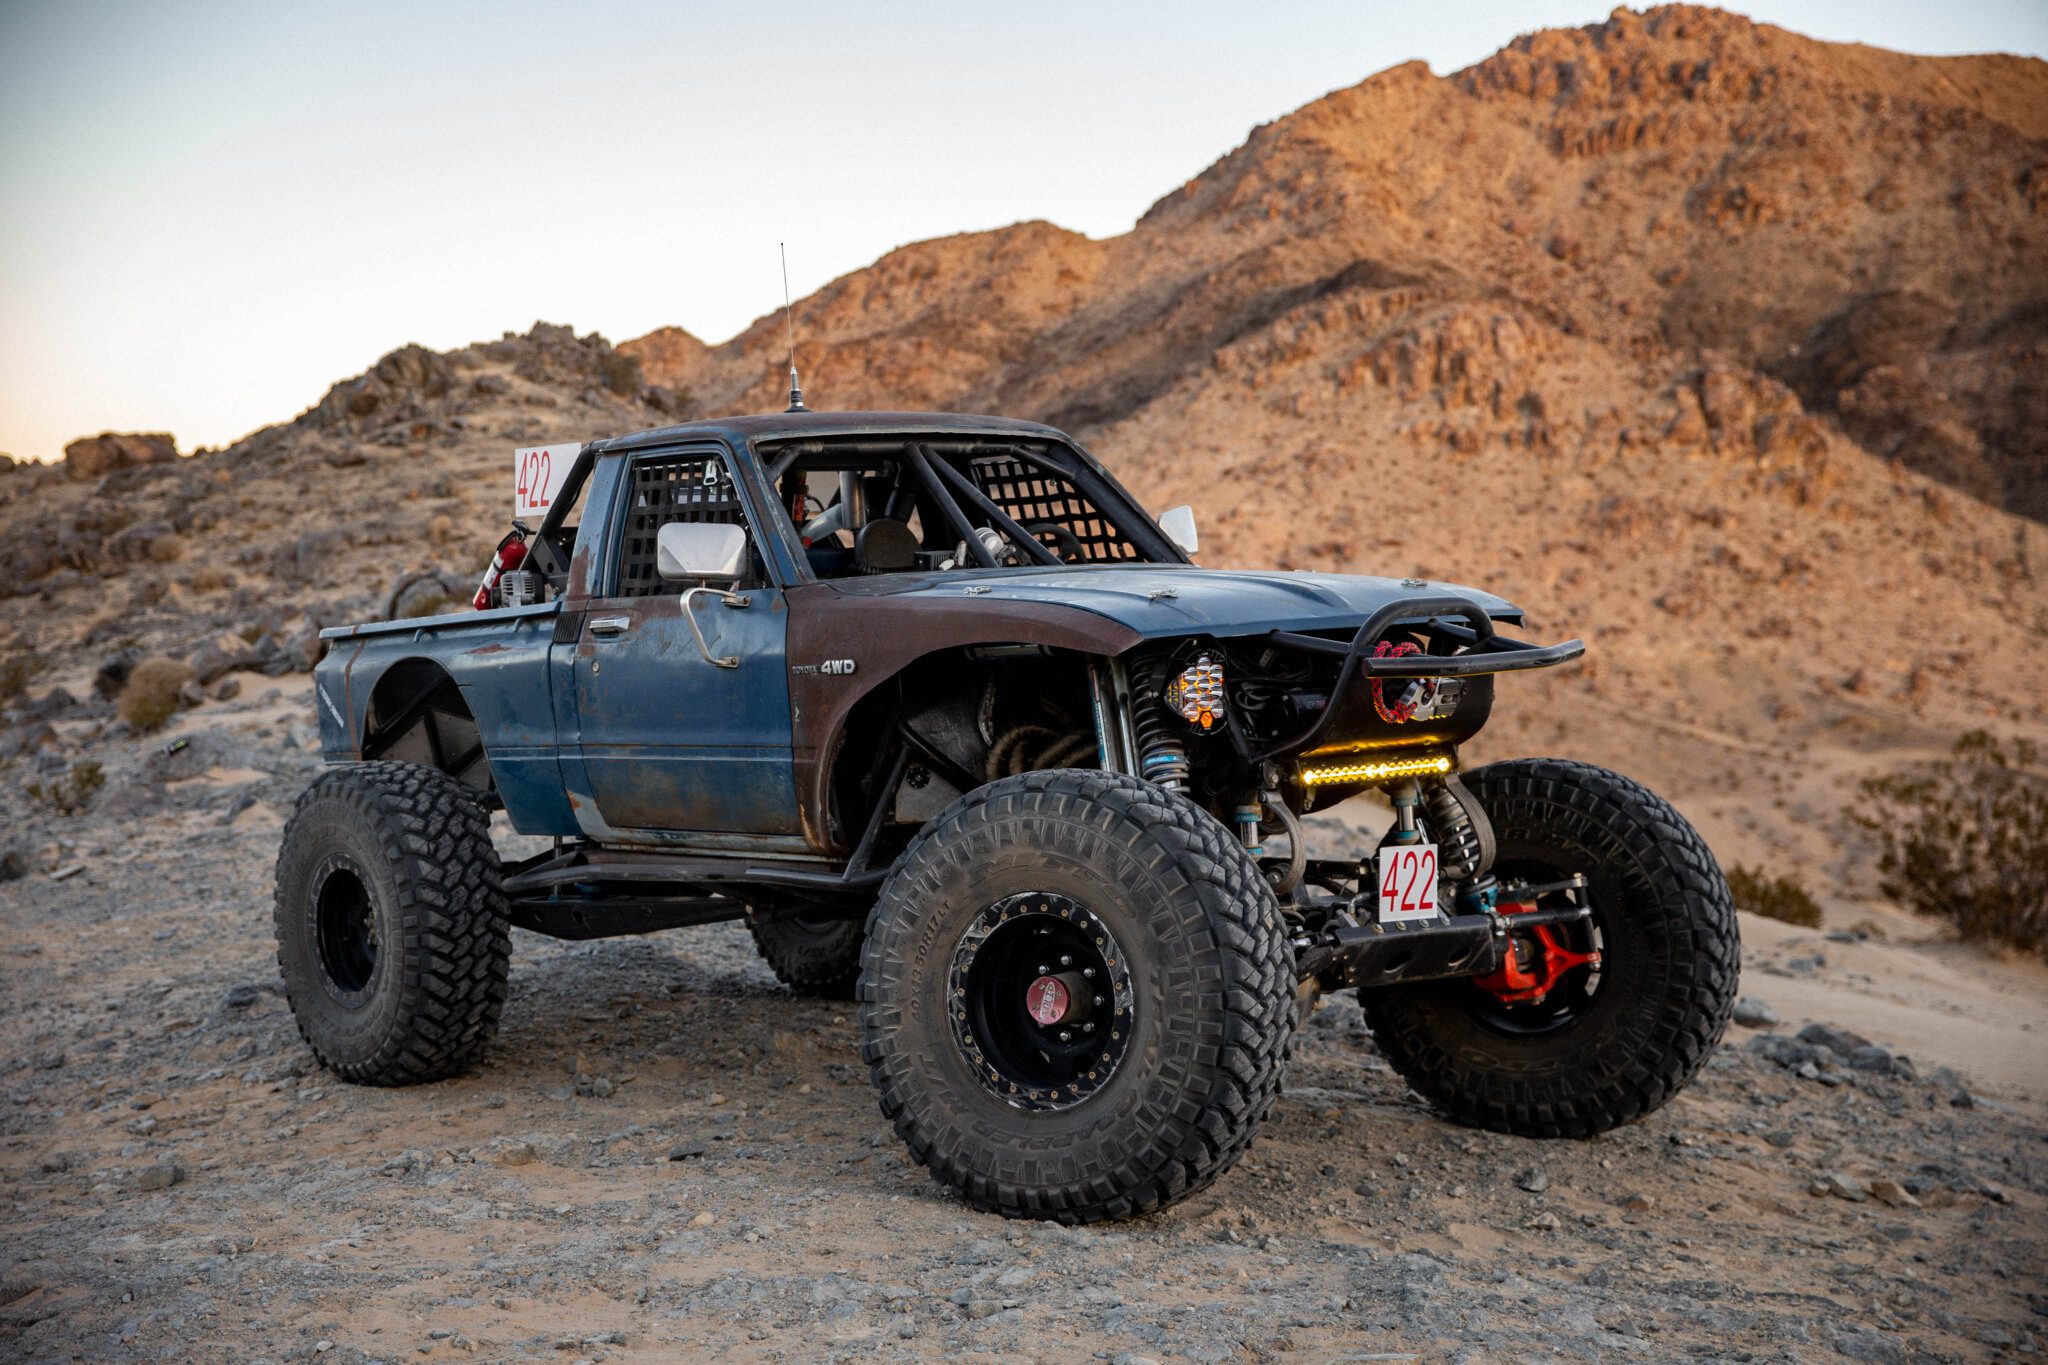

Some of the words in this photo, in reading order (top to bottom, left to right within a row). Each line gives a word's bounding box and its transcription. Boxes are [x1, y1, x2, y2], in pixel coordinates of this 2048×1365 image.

[518, 451, 551, 509] 422
[792, 665, 818, 675] TOYOTA
[821, 659, 856, 675] 4WD
[1382, 850, 1436, 912] 422
